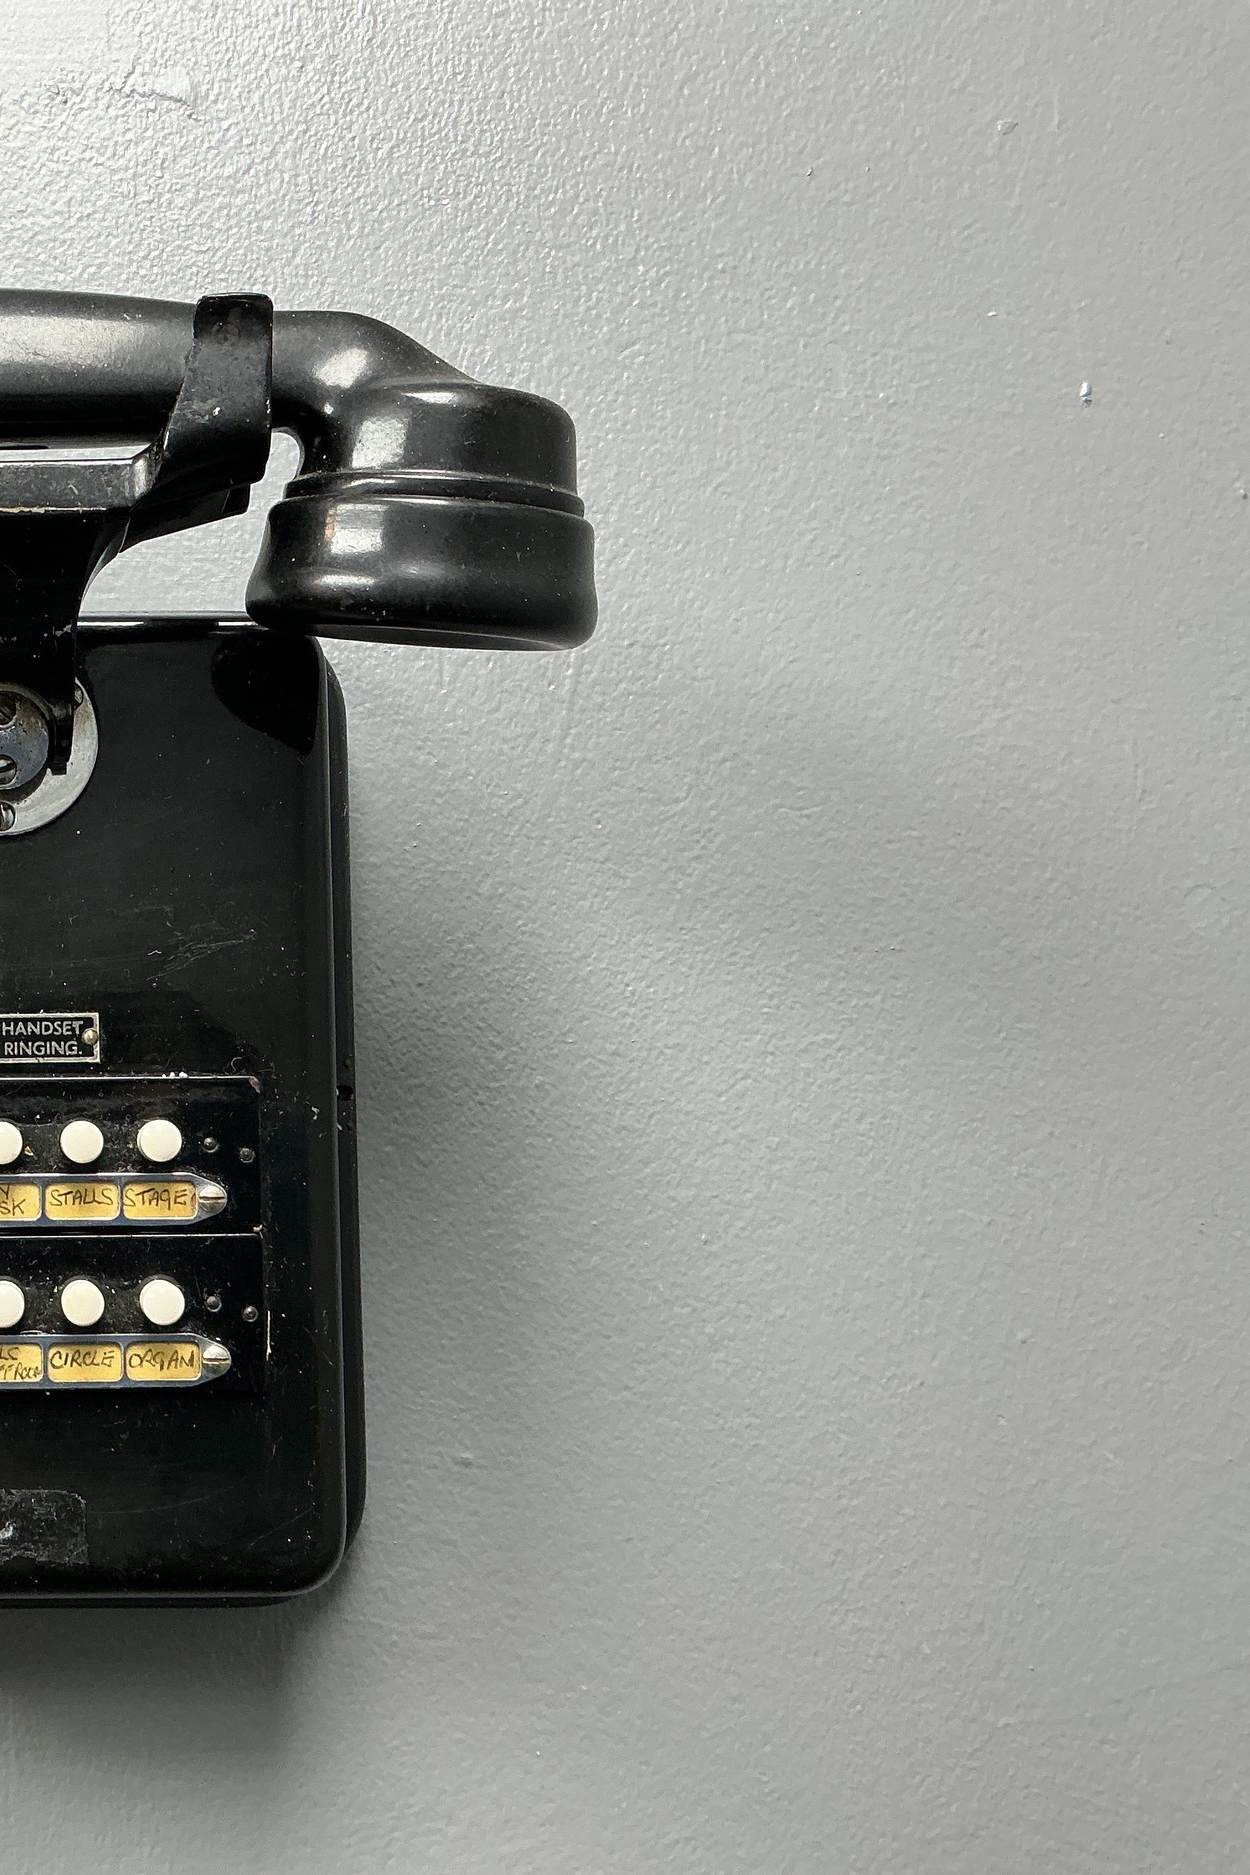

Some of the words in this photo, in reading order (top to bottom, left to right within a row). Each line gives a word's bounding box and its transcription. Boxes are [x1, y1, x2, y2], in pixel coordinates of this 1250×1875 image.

[2, 1021, 84, 1036] HANDSET
[4, 1041, 83, 1056] RINGING.
[50, 1188, 113, 1206] STALLS
[124, 1188, 187, 1210] STAGE
[50, 1350, 115, 1369] CIRCLE
[128, 1348, 195, 1372] ORGAN
